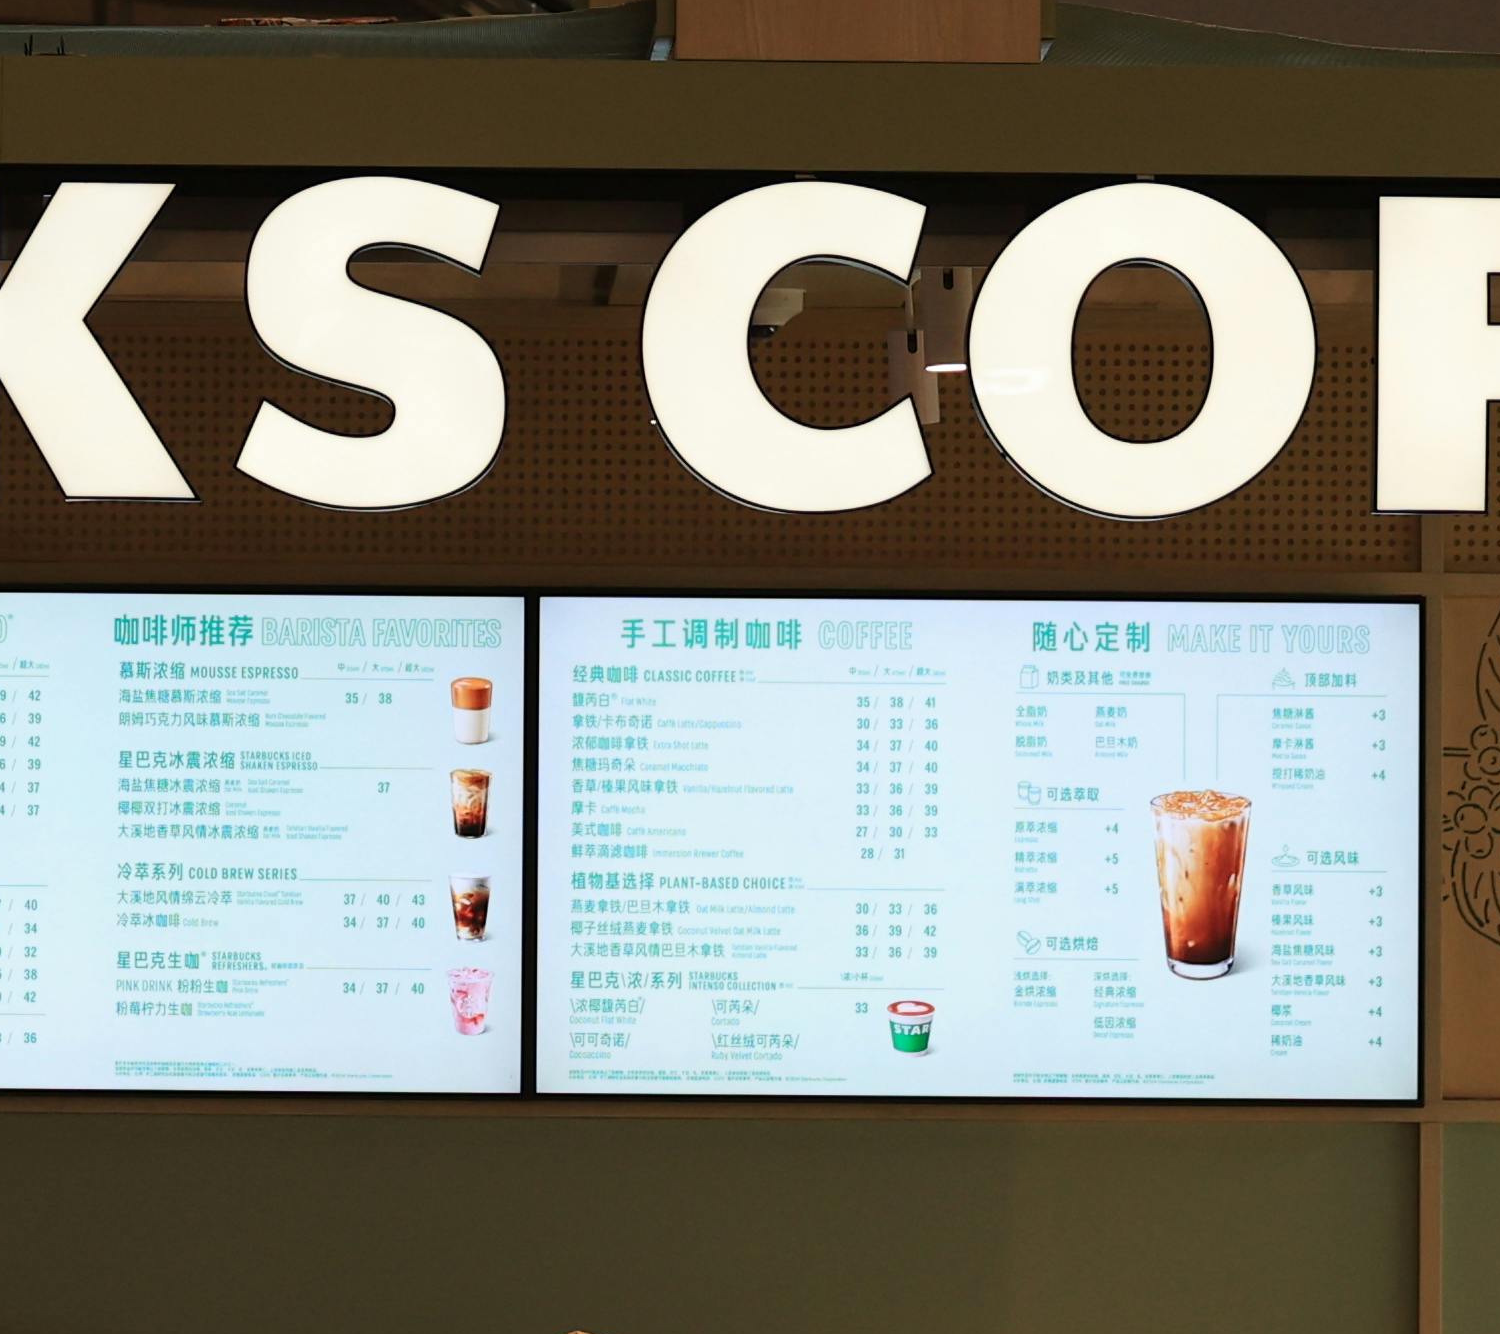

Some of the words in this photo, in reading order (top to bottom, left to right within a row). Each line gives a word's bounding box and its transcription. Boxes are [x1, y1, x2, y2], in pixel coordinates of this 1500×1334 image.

[114, 615, 253, 646] 咖啡师推荐
[261, 617, 367, 646] BARISTA
[372, 618, 501, 647] FAVORITES
[621, 619, 802, 650] 手工调制咖啡
[818, 621, 912, 650] COFFEE
[1033, 622, 1150, 652] 随心定制
[1168, 624, 1241, 653] MAKE
[1250, 625, 1275, 652] IT
[1282, 626, 1370, 654] YOURS
[120, 662, 185, 679] 慕斯浓缩
[191, 666, 237, 679] MOUSSE
[241, 666, 298, 679] ESPRESSO
[572, 665, 639, 683] 经典咖啡
[644, 670, 692, 683] CLASSIC
[695, 670, 736, 683] COFFEE
[1047, 670, 1113, 686] 奶类及其他
[1305, 673, 1357, 688] 顶部加料
[28, 689, 41, 701] 42
[119, 689, 222, 704] 海盐焦糖慕斯浓缩
[345, 692, 359, 705] 35
[378, 692, 392, 705] 38
[856, 696, 870, 709] 35
[890, 696, 904, 709] 38
[925, 696, 936, 709] 41
[27, 712, 41, 724] 39
[572, 714, 653, 729] 拿铁/卡布奇诺
[1371, 709, 1386, 721] +3
[572, 736, 649, 751] 浓郁咖啡拿铁
[1371, 739, 1386, 752] +3
[119, 751, 235, 769] 星巴克冰震浓缩
[240, 751, 289, 760] STARBUCKS
[240, 761, 273, 770] SHAKEN
[275, 762, 318, 771] ESPRESSO
[572, 757, 636, 772] 焦糖玛奇朵
[118, 778, 220, 793] 海盐焦糖冰震浓缩
[378, 781, 390, 793] 37
[1047, 787, 1099, 803] 可选萃取
[572, 800, 597, 816] 摩卡
[572, 822, 622, 837] 美式咖啡
[571, 844, 648, 859] 鲜萃滴滤咖啡
[1307, 850, 1360, 866] 可选风味
[117, 863, 183, 881] 冷萃系列
[189, 867, 218, 880] COLD
[222, 867, 255, 880] BREW
[258, 868, 297, 880] SERIES
[571, 872, 654, 891] 植物基选择
[660, 877, 739, 890] PLANT-BASED
[743, 877, 785, 890] CHOICE
[344, 894, 356, 906] 37
[376, 894, 390, 906] 40
[411, 894, 425, 906] 43
[117, 913, 180, 928] 冷萃冰咖啡
[570, 921, 673, 936] 椰子丝绒燕麦拿铁
[1045, 936, 1099, 952] 可选烘焙
[212, 952, 261, 961] STARBUCKS
[689, 971, 738, 980] STARBUCKS
[116, 979, 139, 992] PINK
[142, 980, 173, 992] DRINK
[178, 979, 228, 994] 粉粉生咖
[689, 982, 724, 990] INTENSO
[727, 982, 776, 991] COLLECTION
[894, 1024, 929, 1035] STAR
